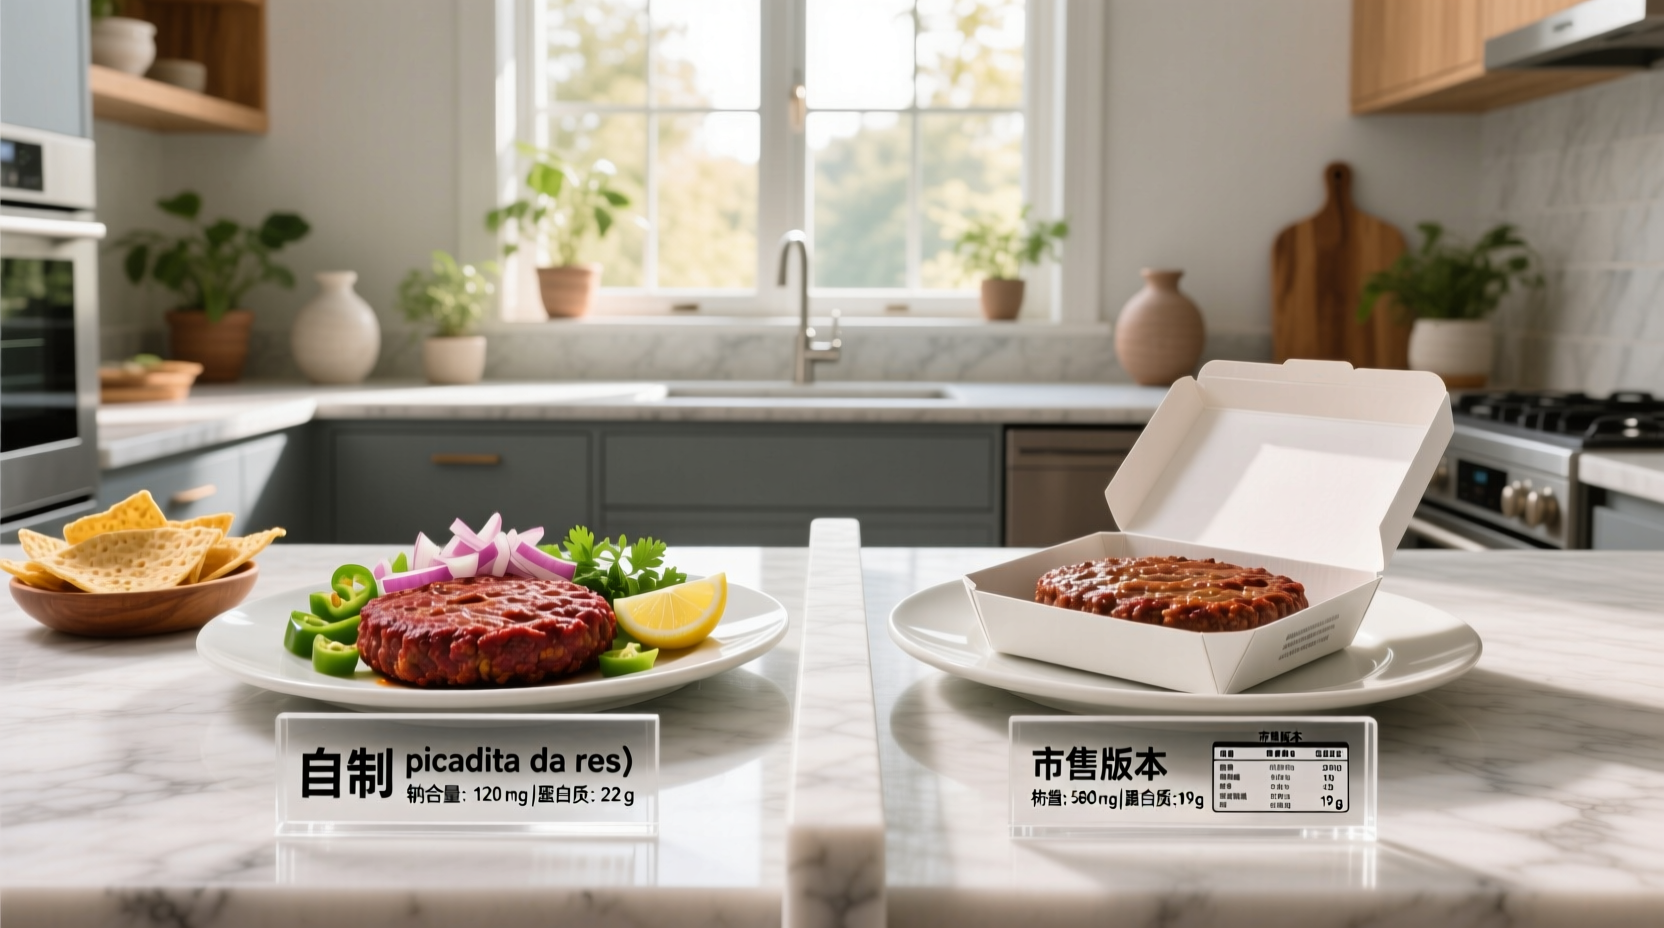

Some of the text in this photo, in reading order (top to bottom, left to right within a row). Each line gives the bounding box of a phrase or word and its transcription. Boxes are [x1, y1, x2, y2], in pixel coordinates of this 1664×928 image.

[302, 746, 393, 798] 自制
[407, 745, 633, 778] picadita da res)
[1032, 746, 1168, 781] 市售版本
[474, 788, 502, 803] 120
